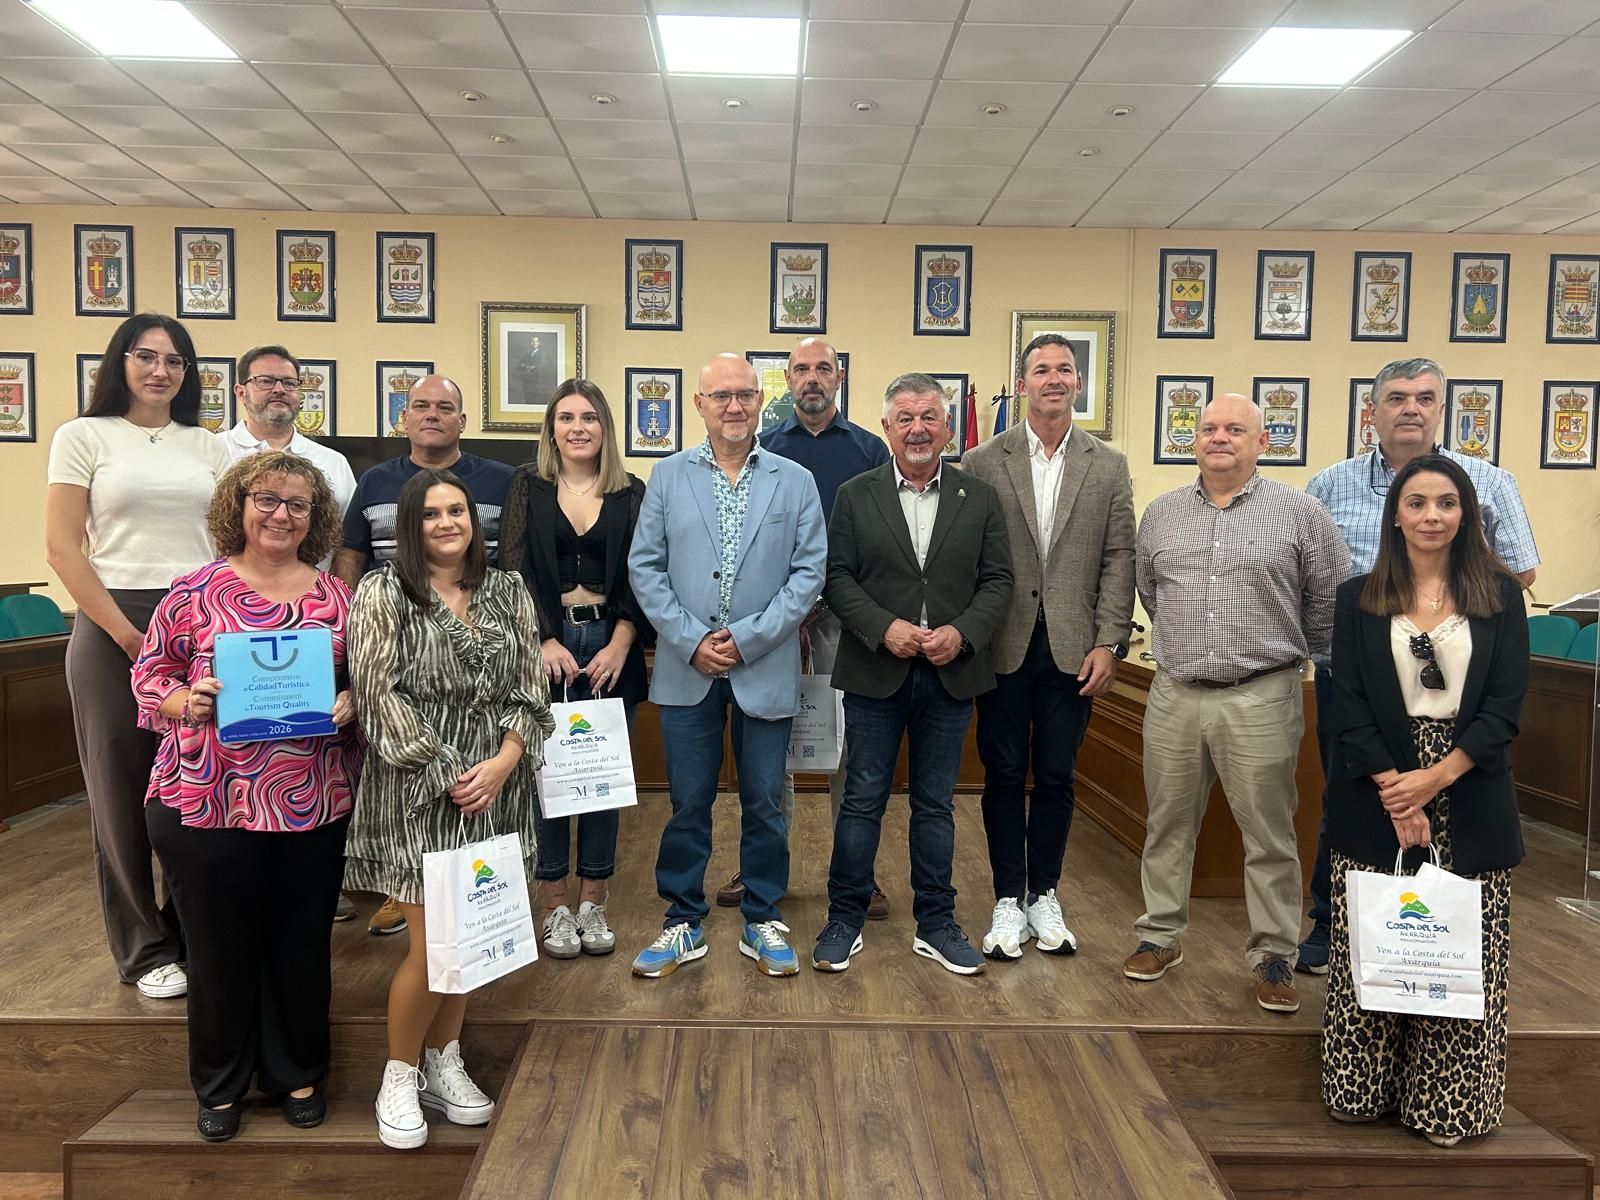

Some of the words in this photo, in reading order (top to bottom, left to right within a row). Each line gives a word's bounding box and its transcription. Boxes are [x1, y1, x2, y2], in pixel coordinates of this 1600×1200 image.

[252, 674, 301, 683] Compromiso
[248, 683, 277, 691] Calidad
[253, 693, 303, 702] Commitment
[282, 700, 310, 709] Quality
[268, 725, 292, 734] 2026
[468, 889, 486, 902] COSTA
[497, 881, 508, 891] SOL
[488, 912, 502, 921] Costa
[1386, 921, 1415, 930] COSTA
[1433, 924, 1450, 933] SOL
[1376, 946, 1392, 954] Ven
